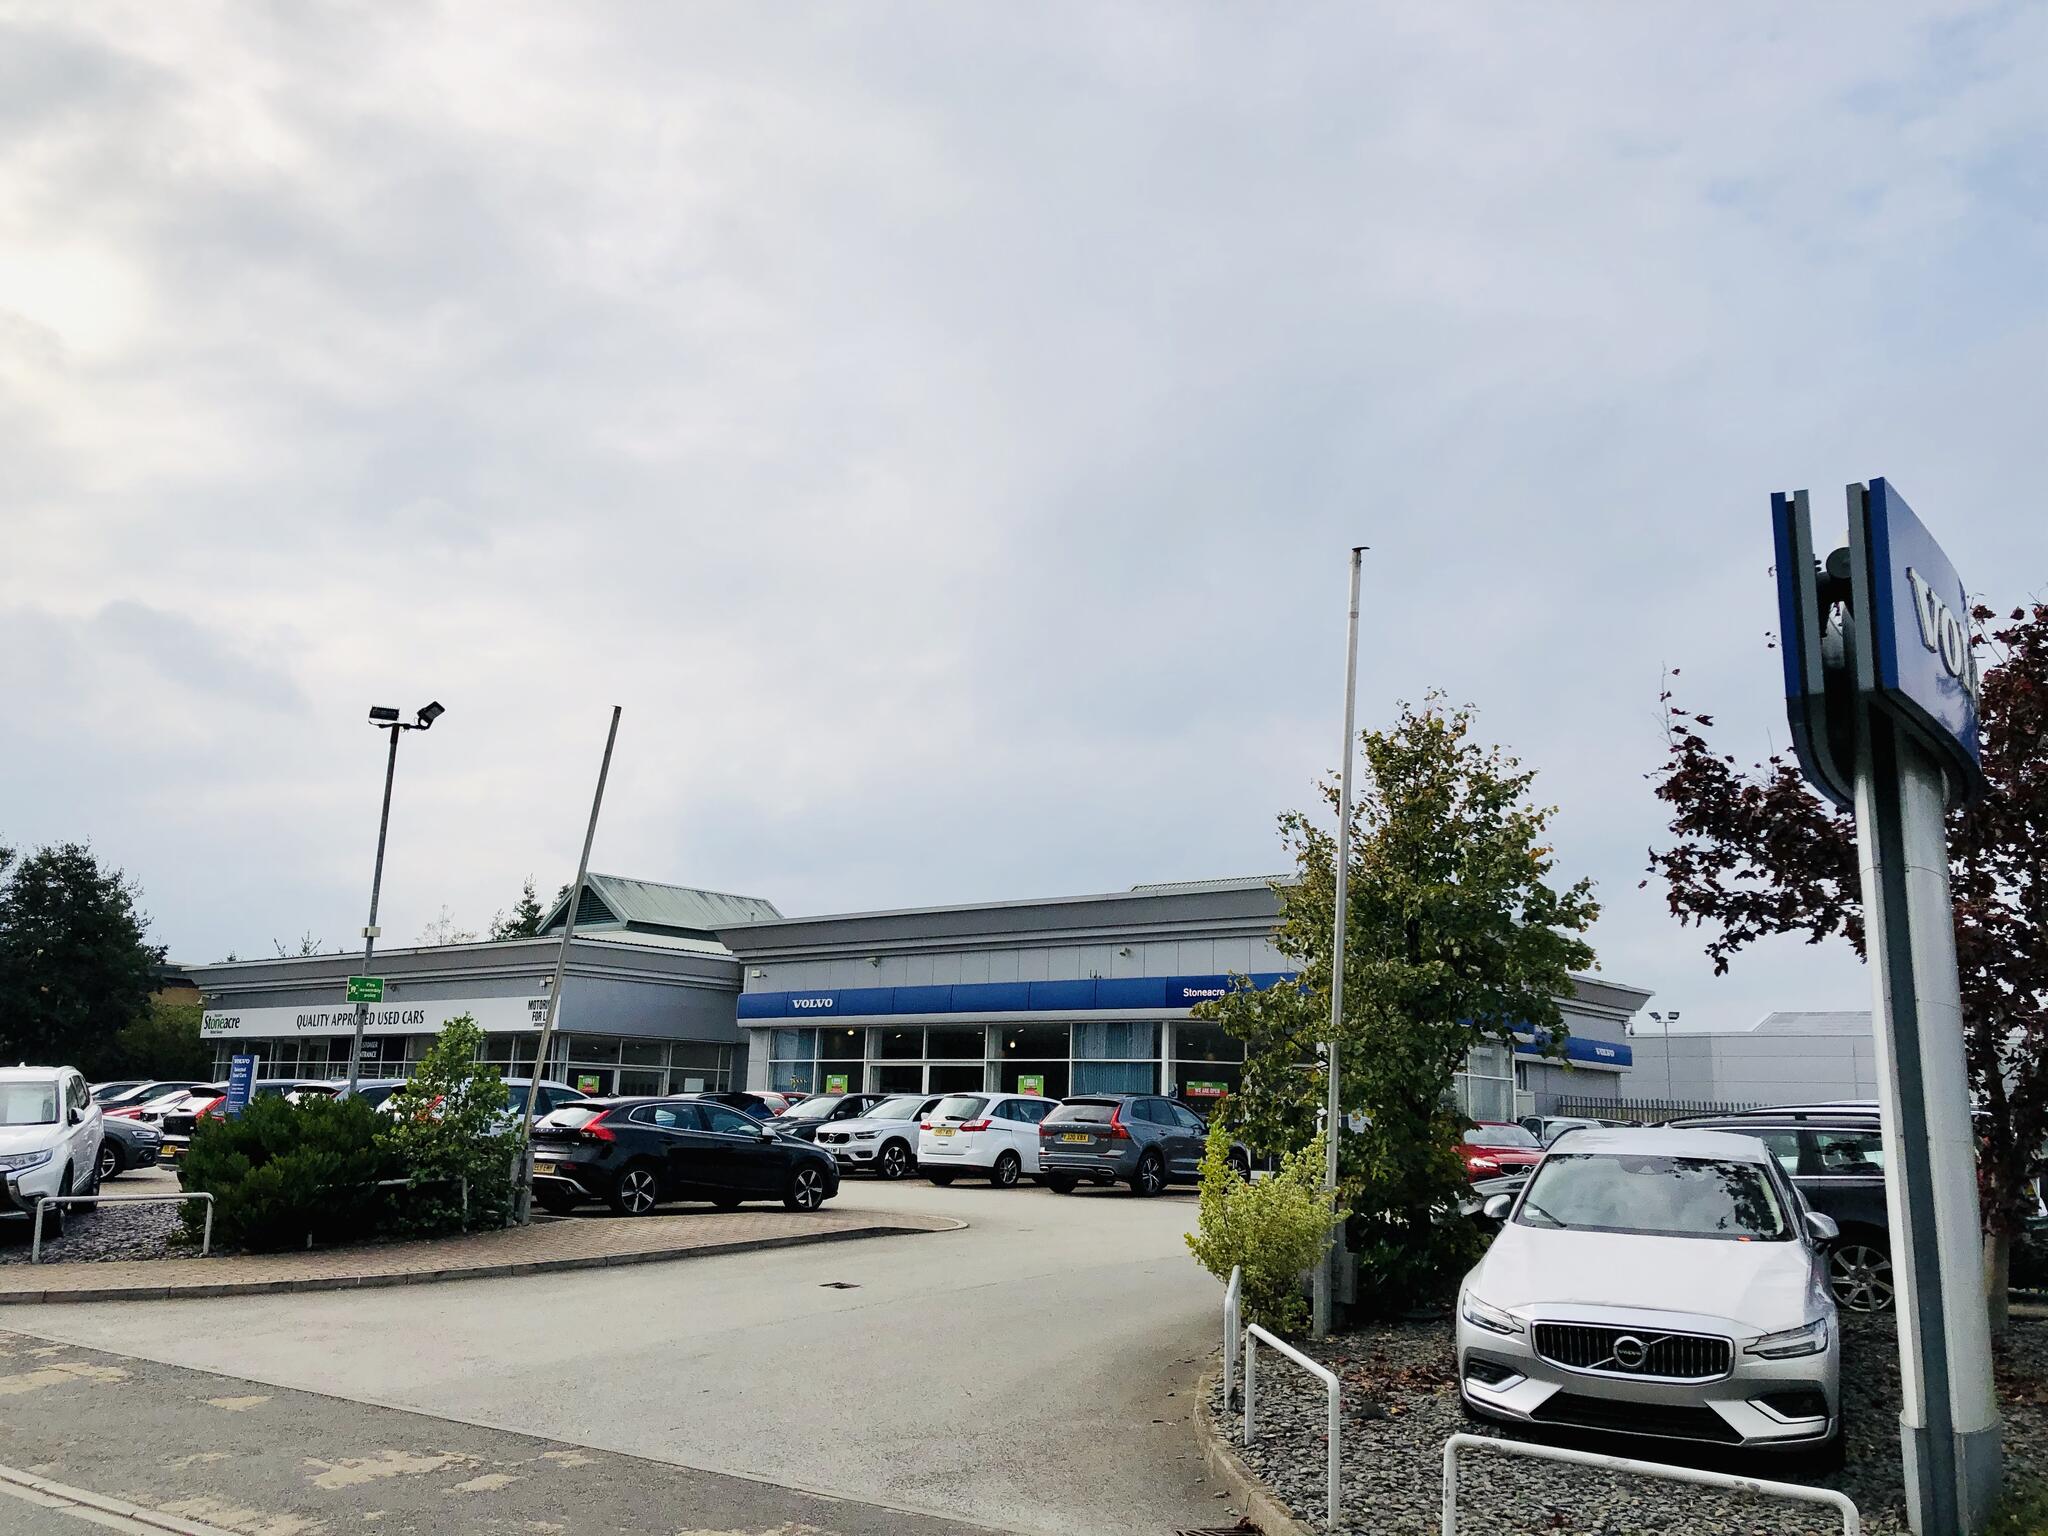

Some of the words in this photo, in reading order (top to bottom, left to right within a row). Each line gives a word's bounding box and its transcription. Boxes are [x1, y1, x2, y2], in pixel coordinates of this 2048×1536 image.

[1183, 987, 1225, 997] Stoneacre
[792, 998, 834, 1009] VOLVO
[296, 1014, 330, 1031] QUALITY
[331, 1011, 375, 1027] APPROED
[377, 1011, 400, 1026] USED
[402, 1010, 425, 1025] CARS
[531, 1011, 543, 1021] FOR
[203, 1015, 241, 1030] Stoneacre
